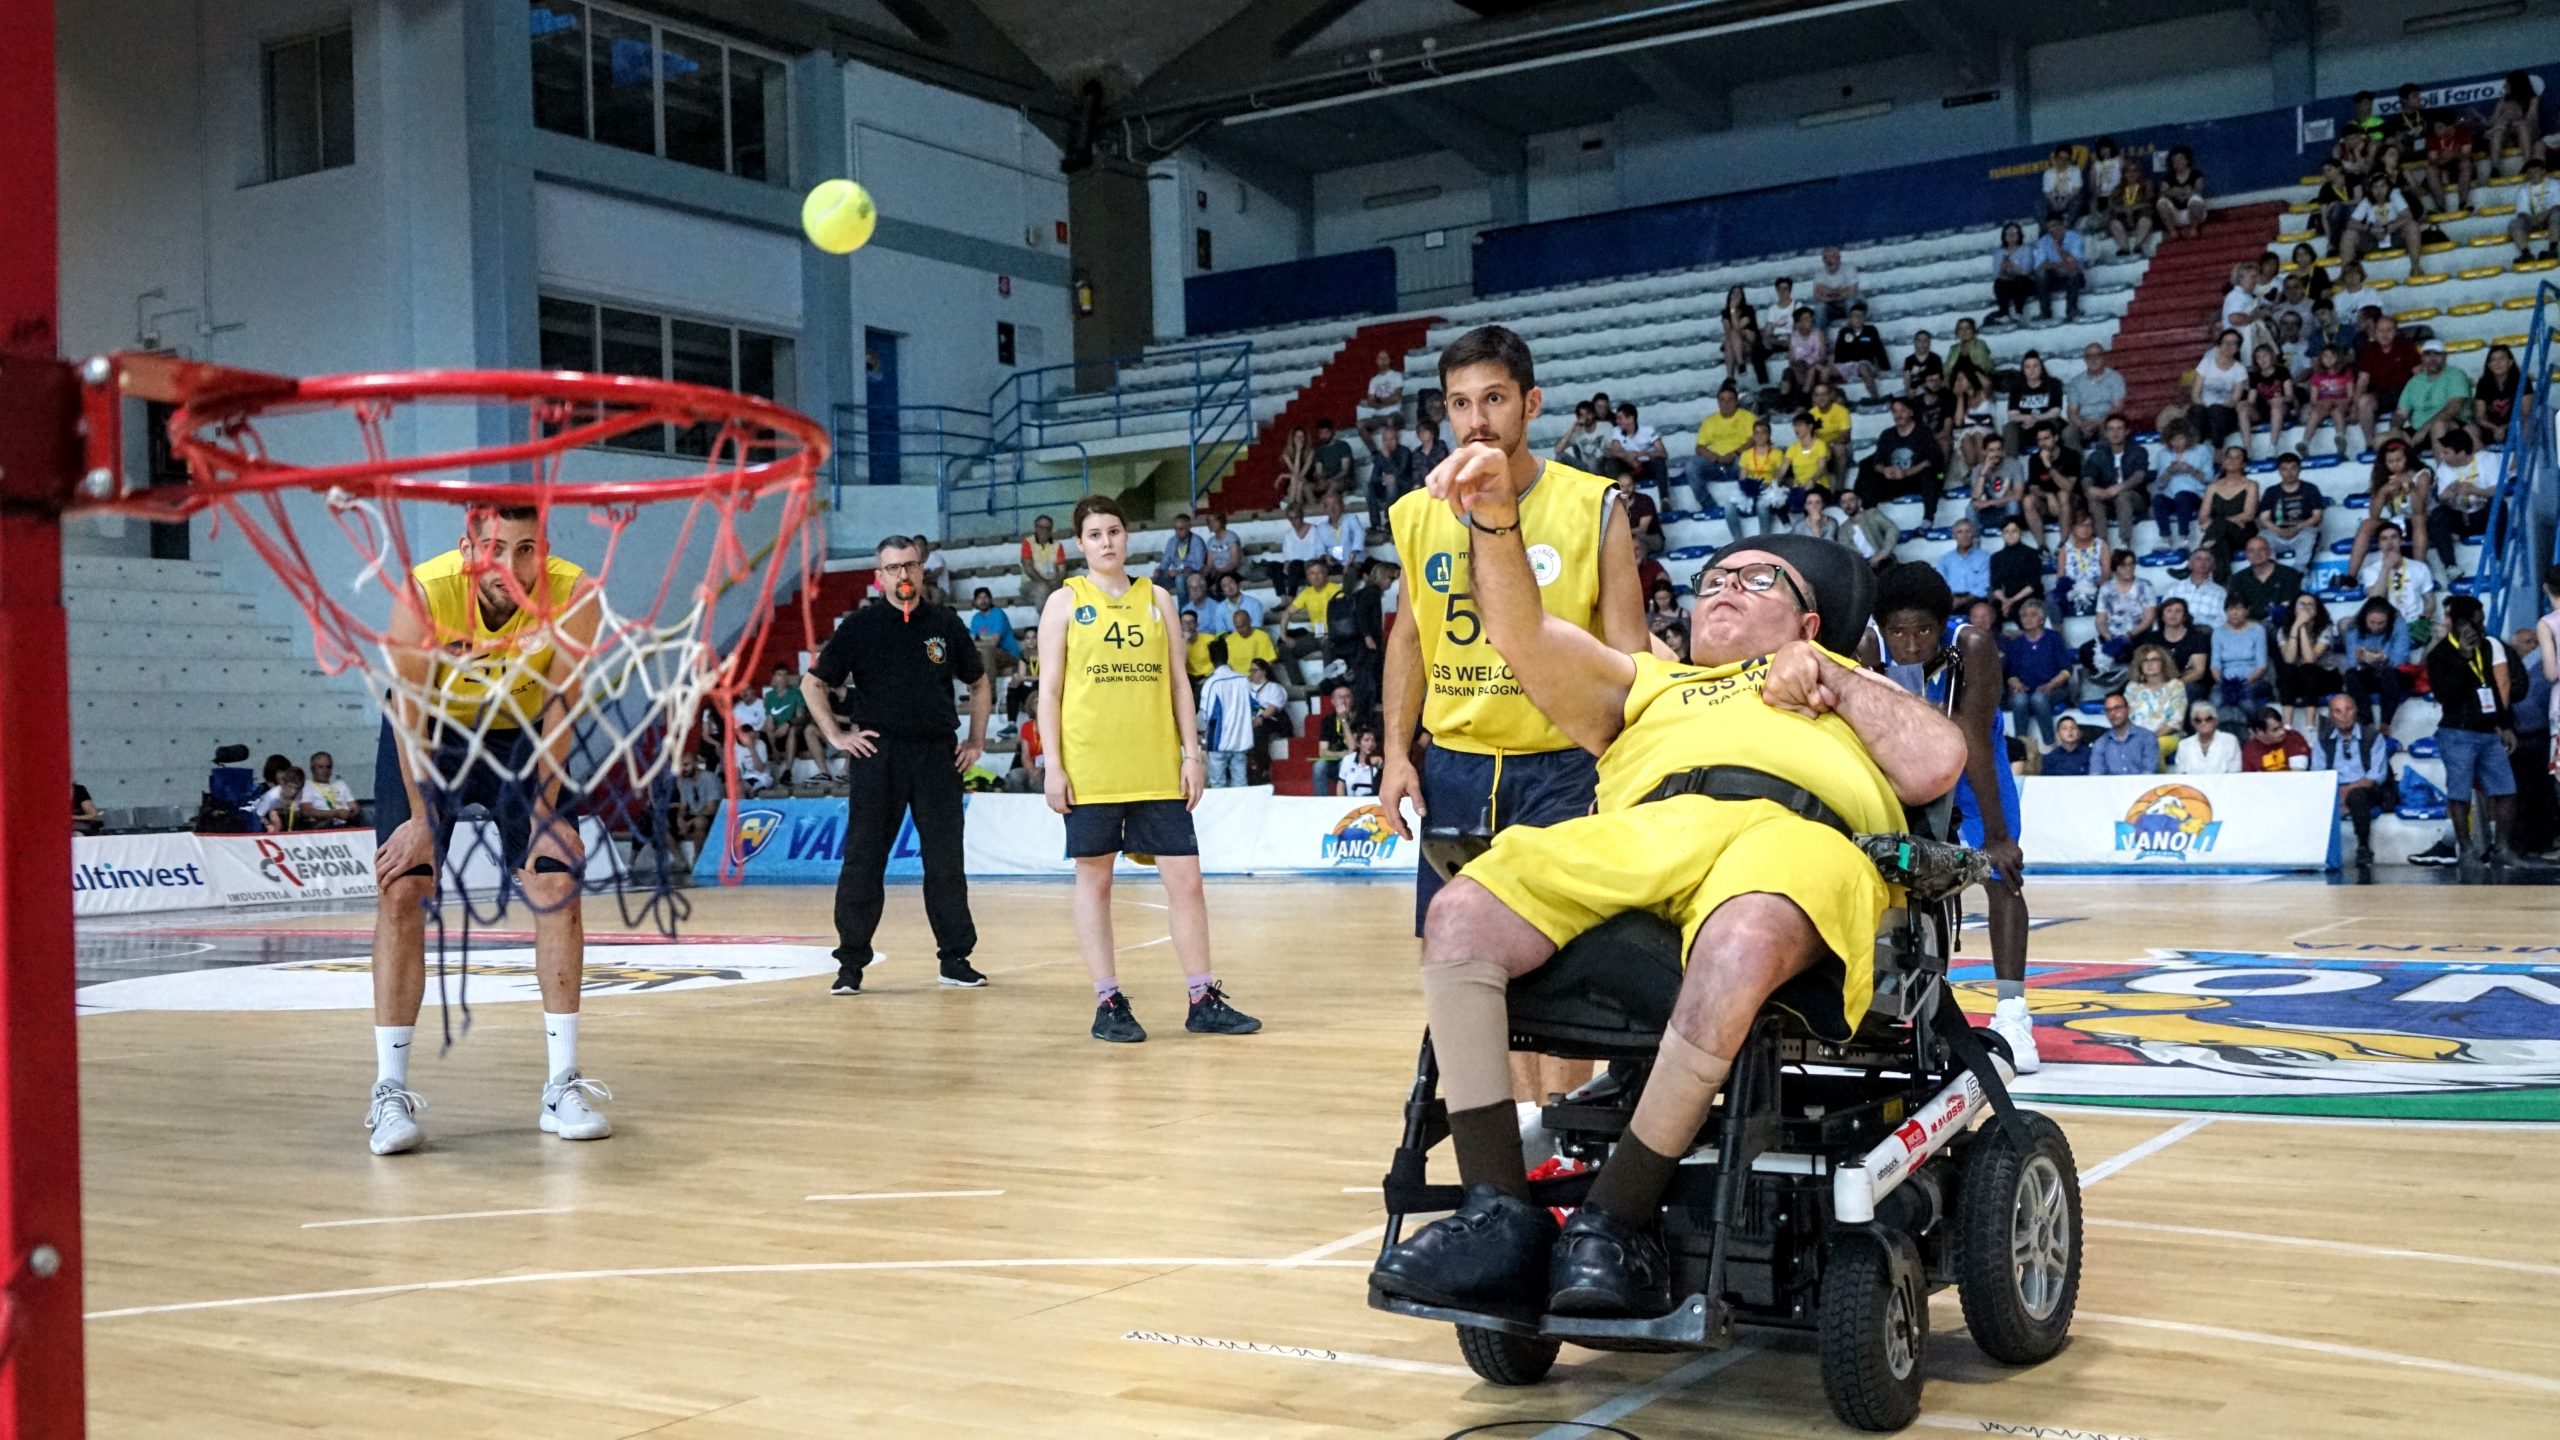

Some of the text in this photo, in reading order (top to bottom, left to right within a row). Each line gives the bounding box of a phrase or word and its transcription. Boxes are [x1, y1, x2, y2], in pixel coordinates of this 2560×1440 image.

[1103, 621, 1144, 650] 45
[1086, 663, 1163, 675] PGS WELCOME
[1095, 675, 1123, 684] BASKIN
[1434, 683, 1475, 697] BASKIN
[1681, 677, 1736, 705] PGS
[1325, 840, 1392, 860] VANOLI
[2120, 831, 2212, 853] VANOLI
